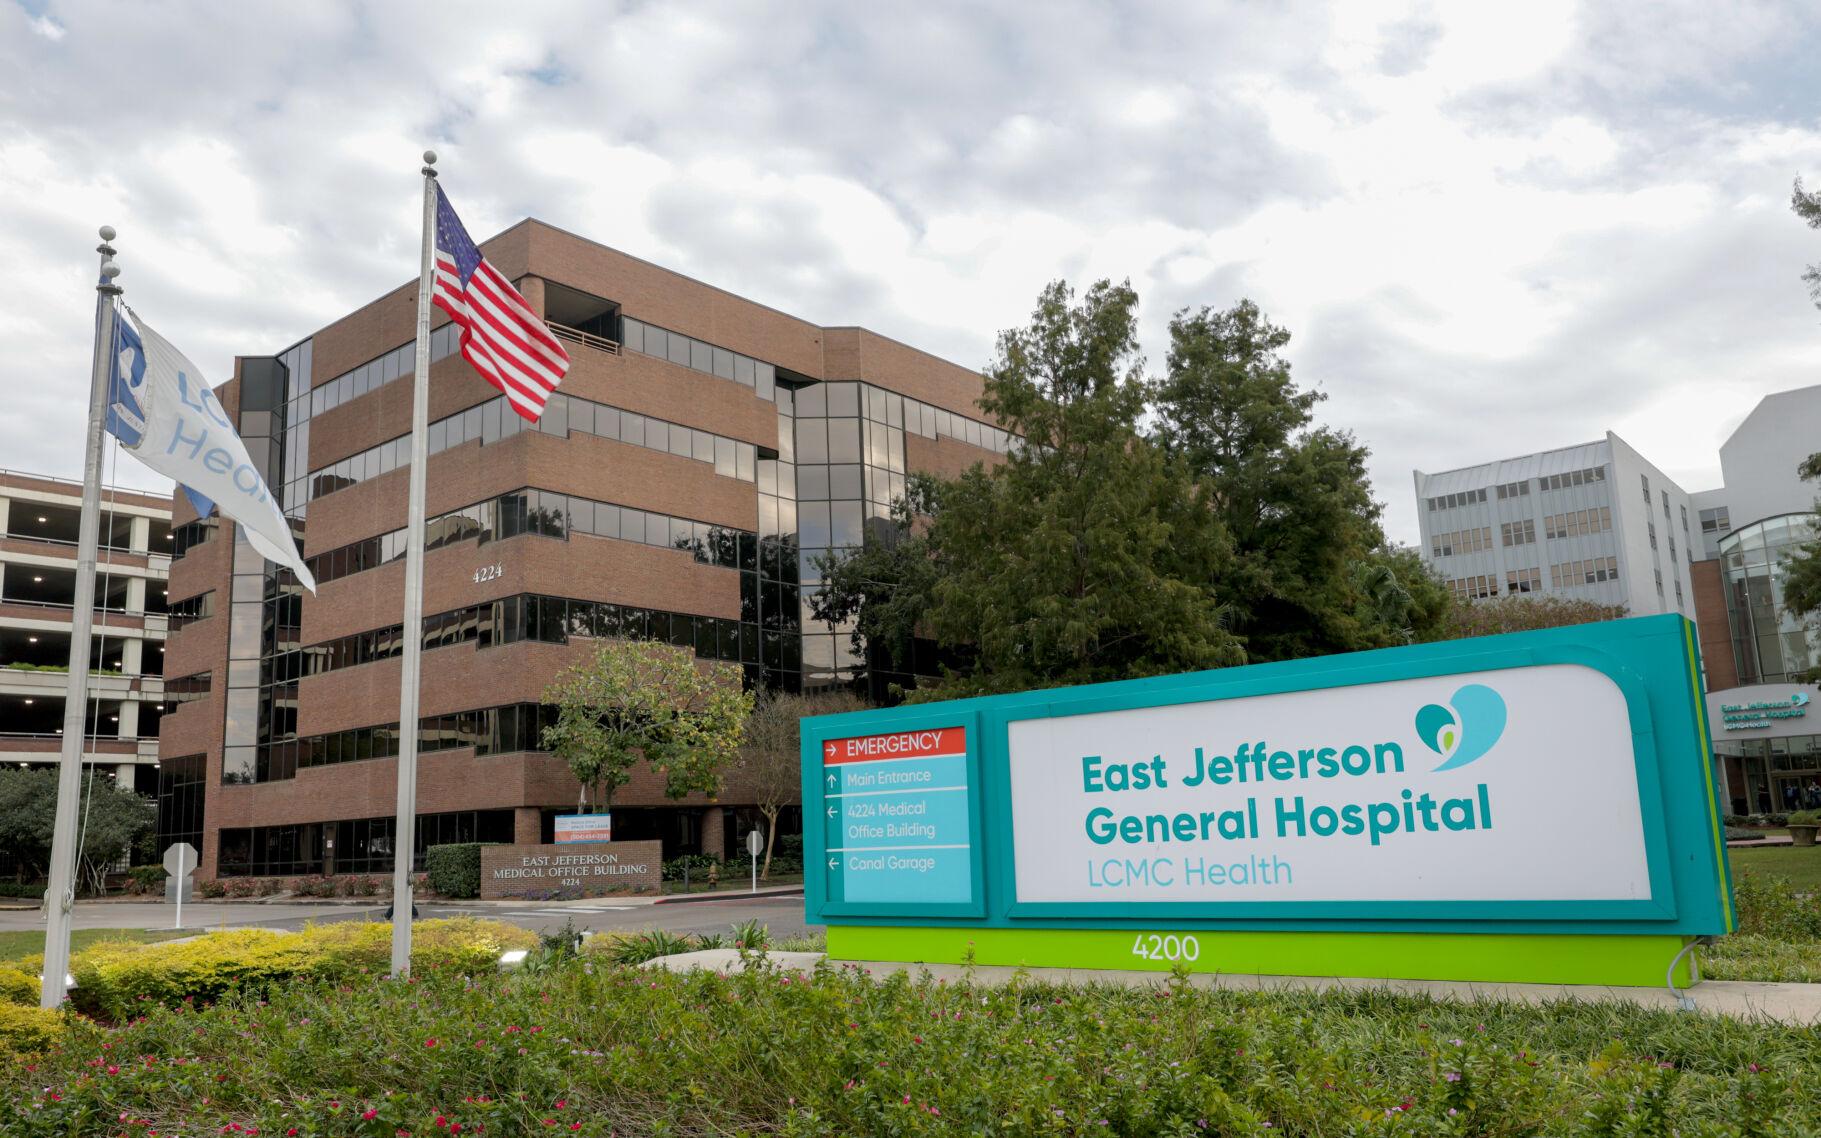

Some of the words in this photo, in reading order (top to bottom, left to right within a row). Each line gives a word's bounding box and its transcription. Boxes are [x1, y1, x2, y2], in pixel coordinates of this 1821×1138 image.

[178, 370, 241, 440] LC
[473, 561, 502, 583] 4224
[847, 731, 942, 756] EMERGENCY
[847, 772, 875, 786] Main
[878, 770, 931, 785] Entrance
[1082, 754, 1167, 793] East
[1182, 741, 1405, 787] Jefferson
[848, 803, 875, 817] 4224
[878, 800, 926, 816] Medical
[1085, 798, 1258, 845] General
[1275, 783, 1492, 846] Hospital
[848, 824, 884, 838] Office
[887, 822, 936, 839] Building
[494, 868, 545, 879] MEDICAL
[549, 866, 590, 877] OFFICE
[594, 864, 648, 875] BUILDING
[523, 857, 549, 867] EAST
[552, 854, 618, 866] JEFFERSON
[849, 856, 884, 870] Canal
[887, 856, 936, 872] Garage
[1088, 858, 1174, 887] LCMC
[1184, 855, 1292, 886] Health
[1132, 935, 1199, 961] 4200
